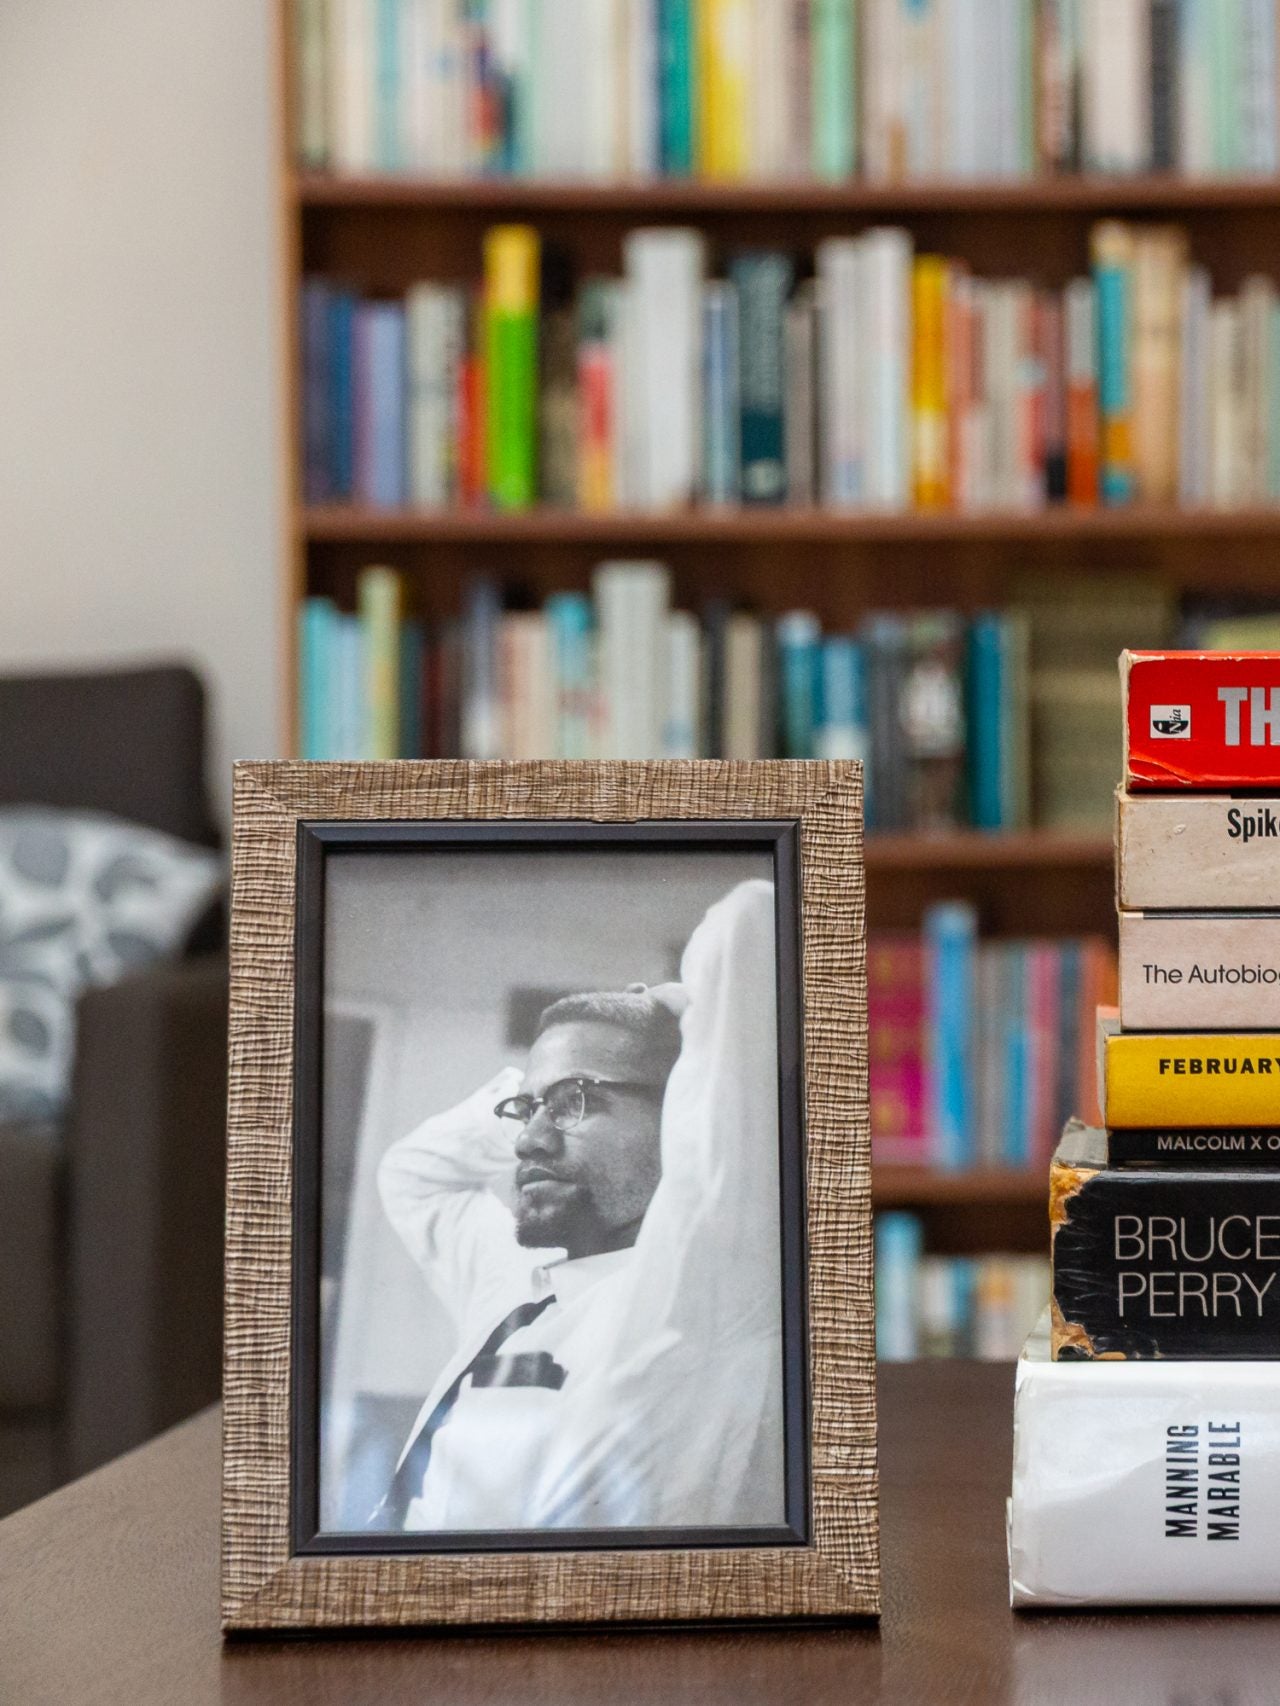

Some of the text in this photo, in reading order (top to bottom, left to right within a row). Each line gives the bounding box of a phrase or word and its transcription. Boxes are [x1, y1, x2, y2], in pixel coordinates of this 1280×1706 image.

[1143, 964, 1182, 983] The
[1157, 1136, 1245, 1151] MALCOLM
[1250, 1136, 1262, 1150] X
[1118, 1271, 1276, 1317] PERRY
[1165, 1424, 1199, 1538] MANNING
[1207, 1421, 1241, 1541] MARABLE
